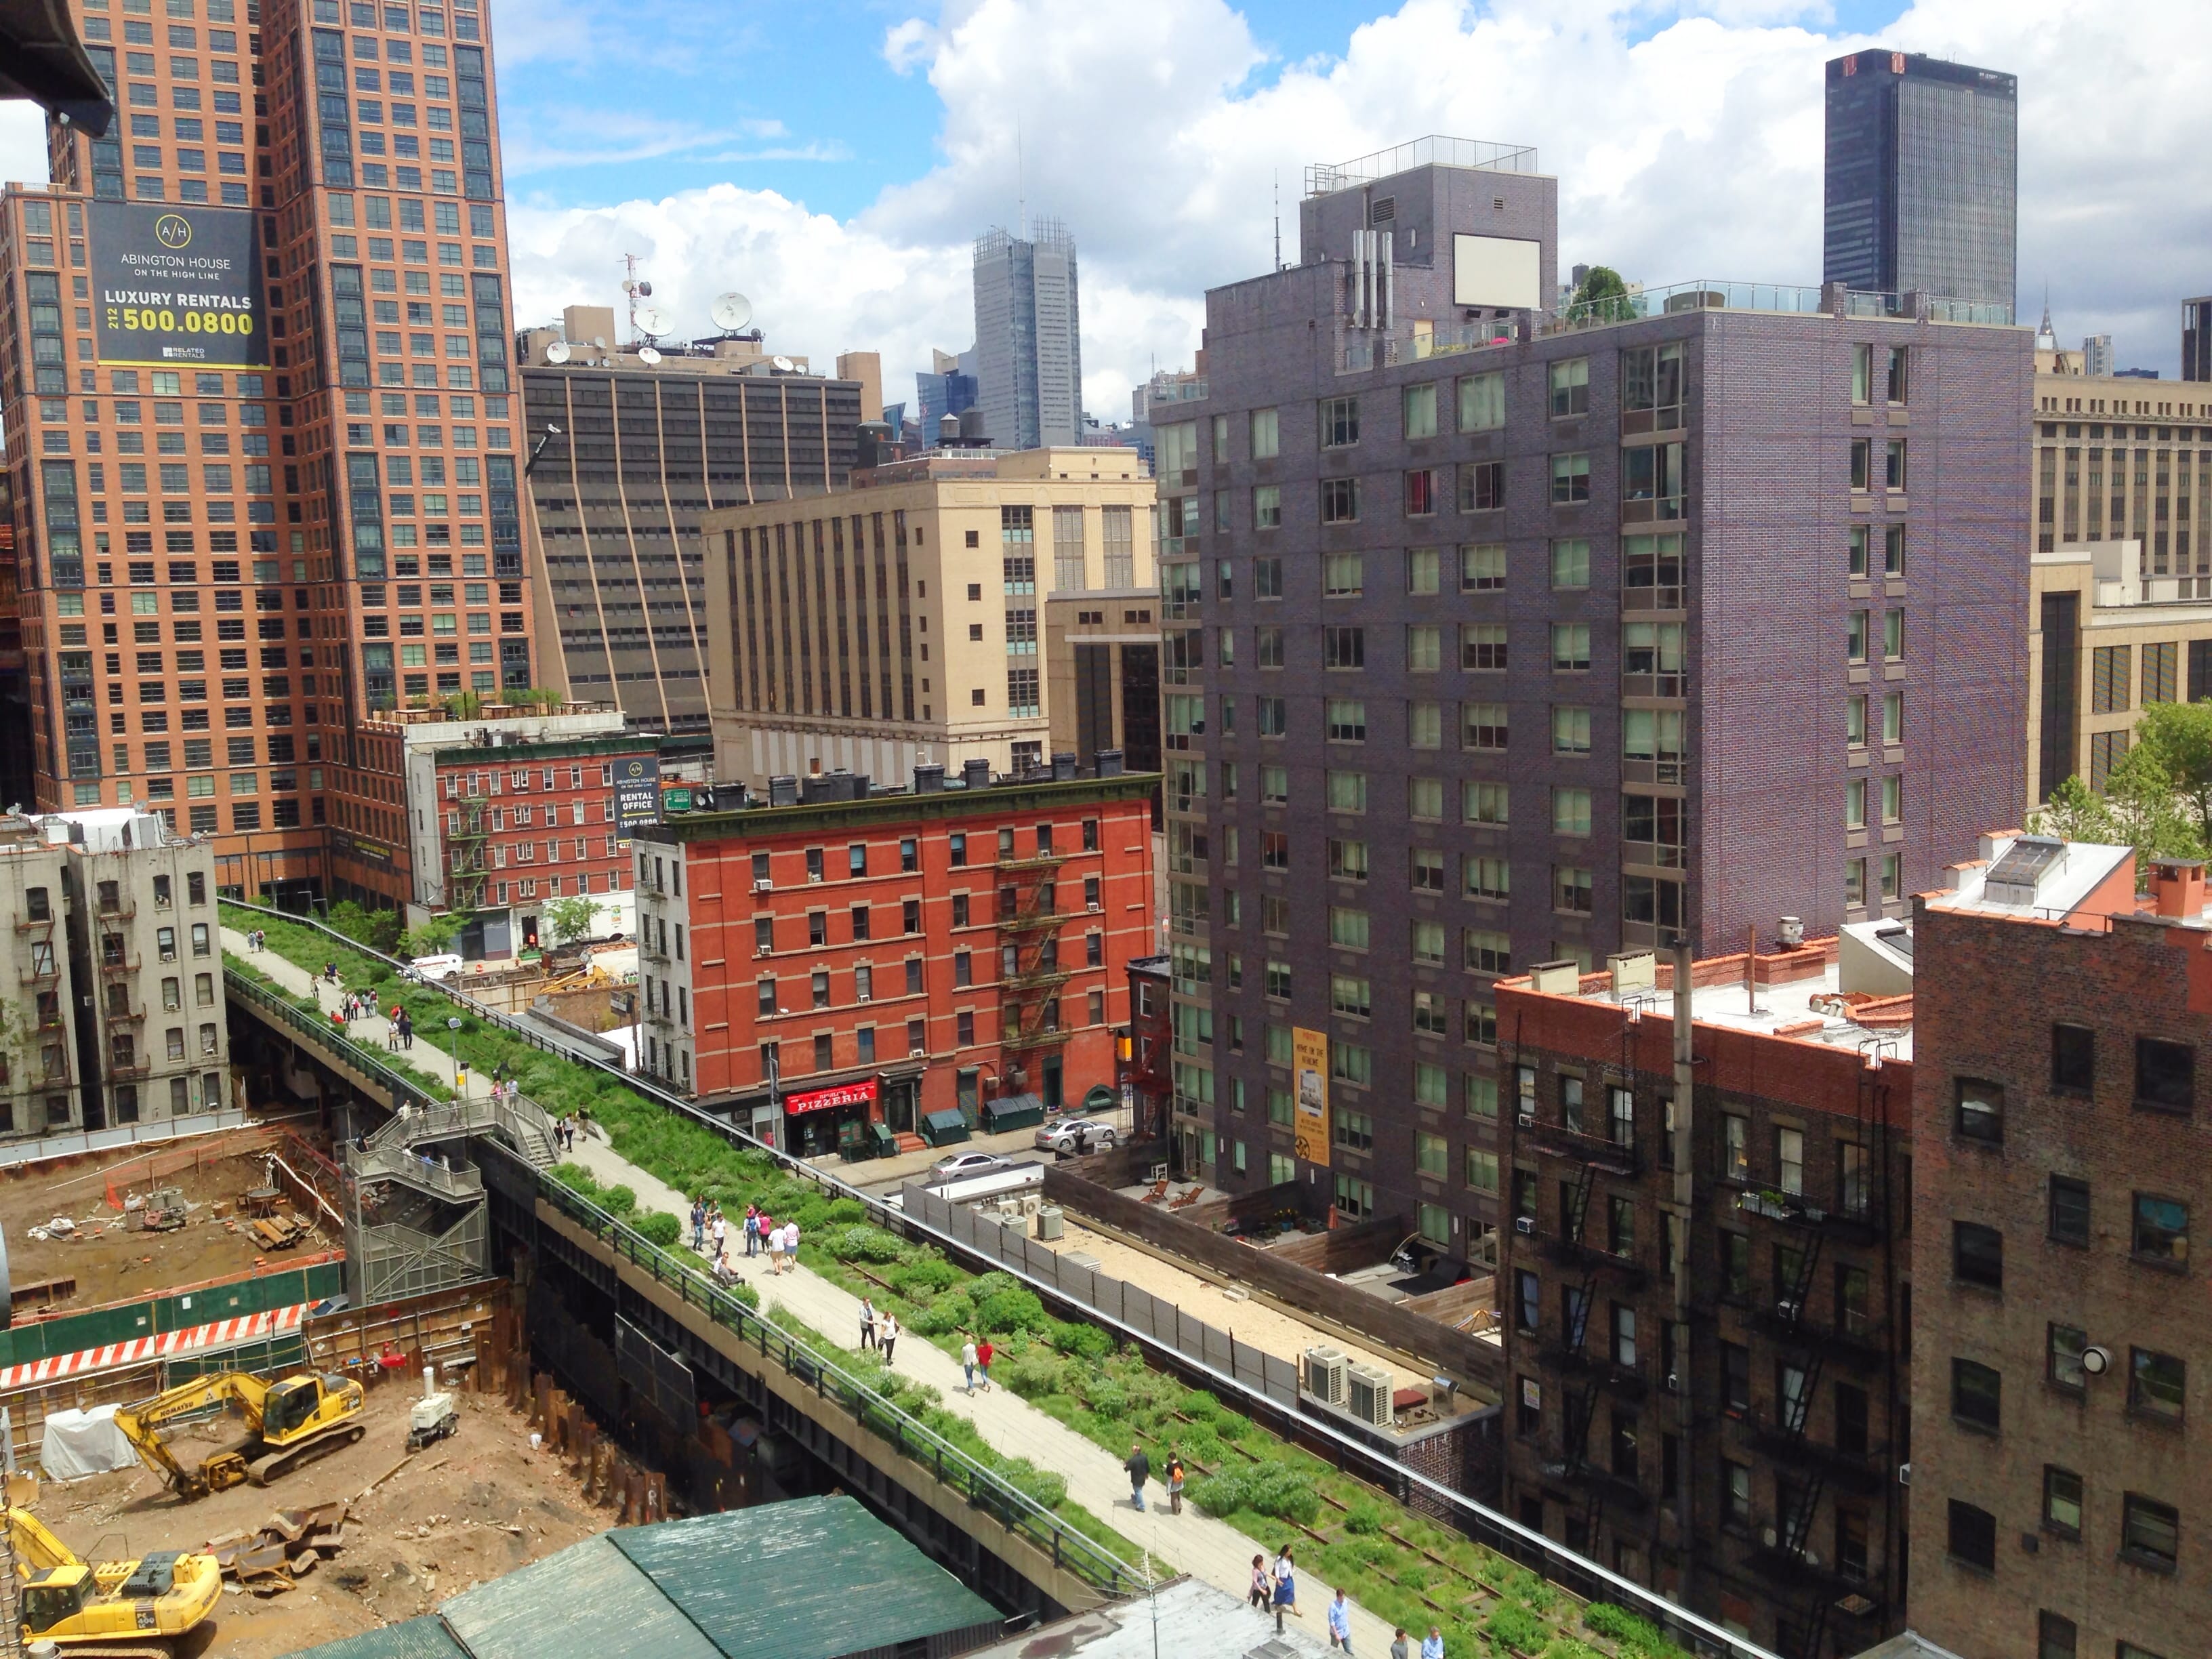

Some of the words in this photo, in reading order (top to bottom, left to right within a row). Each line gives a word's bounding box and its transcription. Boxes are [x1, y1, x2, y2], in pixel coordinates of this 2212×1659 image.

[162, 222, 186, 241] A/H
[121, 253, 184, 266] ABINGTON
[189, 258, 230, 269] HOUSE
[172, 270, 195, 279] HIGH
[199, 272, 220, 280] LINE
[104, 290, 171, 305] LUXURY
[178, 293, 252, 309] RENTALS
[107, 308, 119, 329] 212
[123, 308, 253, 335] 500.0800
[620, 792, 653, 802] RENTAL
[622, 801, 652, 810] OFFICE
[798, 1091, 868, 1111] PIZZERIA
[160, 1401, 194, 1417] KOMATSU
